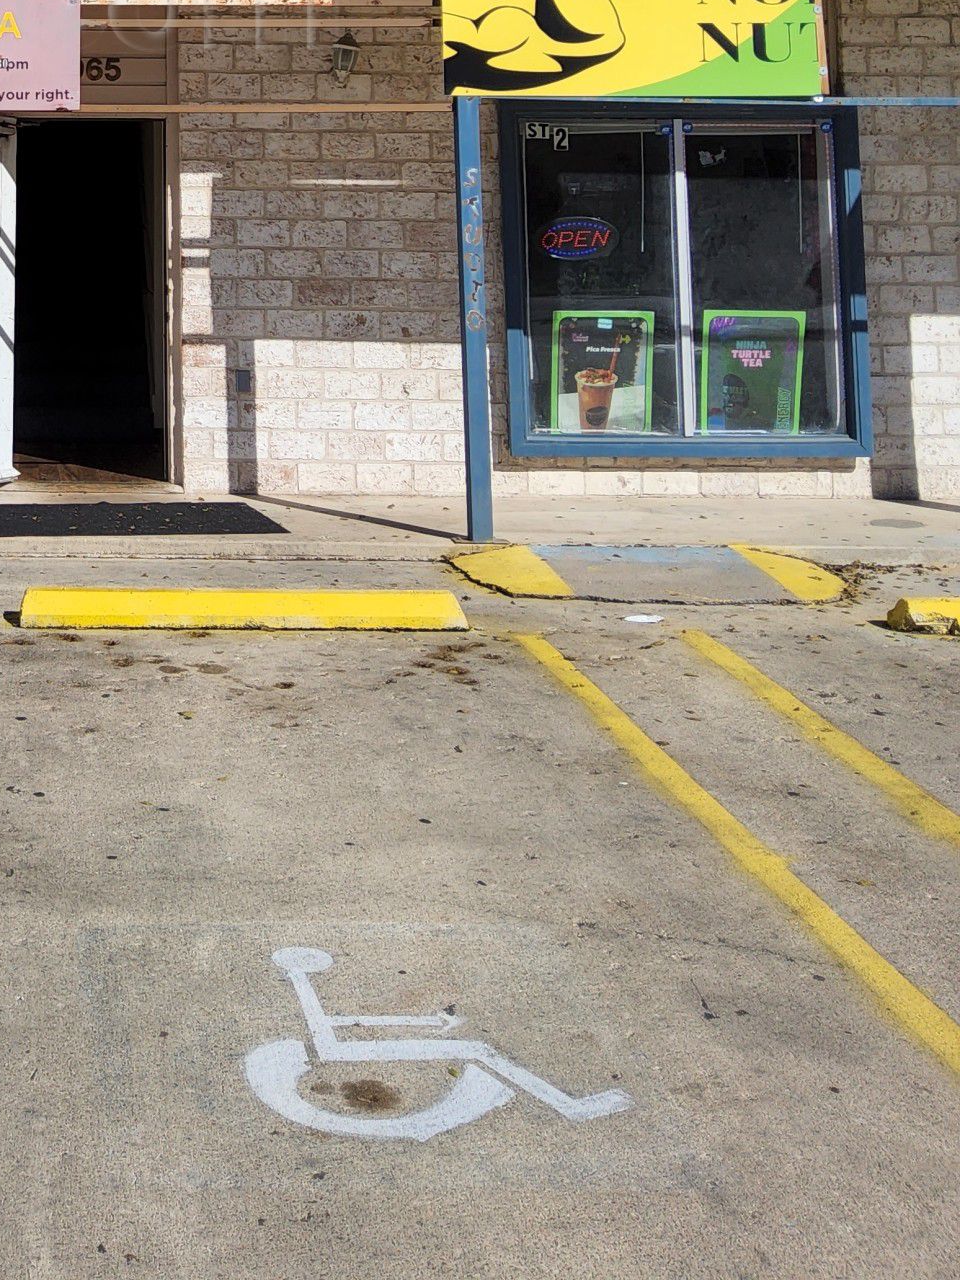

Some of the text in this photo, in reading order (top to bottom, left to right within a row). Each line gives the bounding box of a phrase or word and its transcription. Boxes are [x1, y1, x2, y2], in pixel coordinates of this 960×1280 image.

[80, 57, 122, 82] 65
[35, 88, 74, 103] right.
[527, 123, 568, 150] ST 2
[541, 228, 611, 252] OPEN
[735, 340, 767, 350] NINJA
[731, 349, 772, 359] TURTLE
[741, 358, 763, 367] TEA
